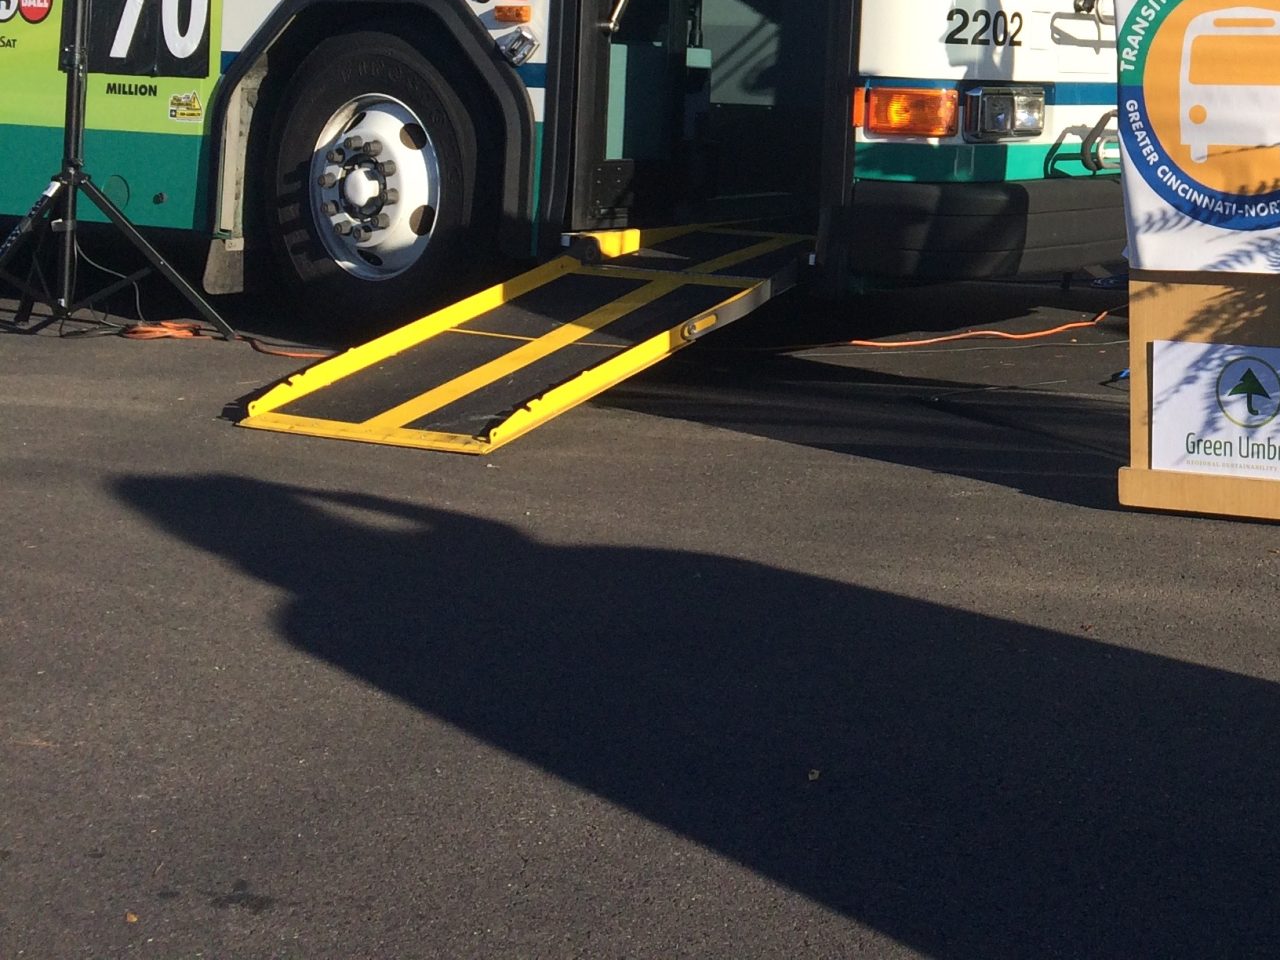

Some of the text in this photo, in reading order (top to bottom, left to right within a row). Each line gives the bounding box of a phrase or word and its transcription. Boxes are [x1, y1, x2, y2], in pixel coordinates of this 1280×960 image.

[944, 8, 1024, 47] 2202
[106, 82, 158, 97] MILLION
[1126, 100, 1159, 166] GREATER
[1185, 432, 1233, 457] Green
